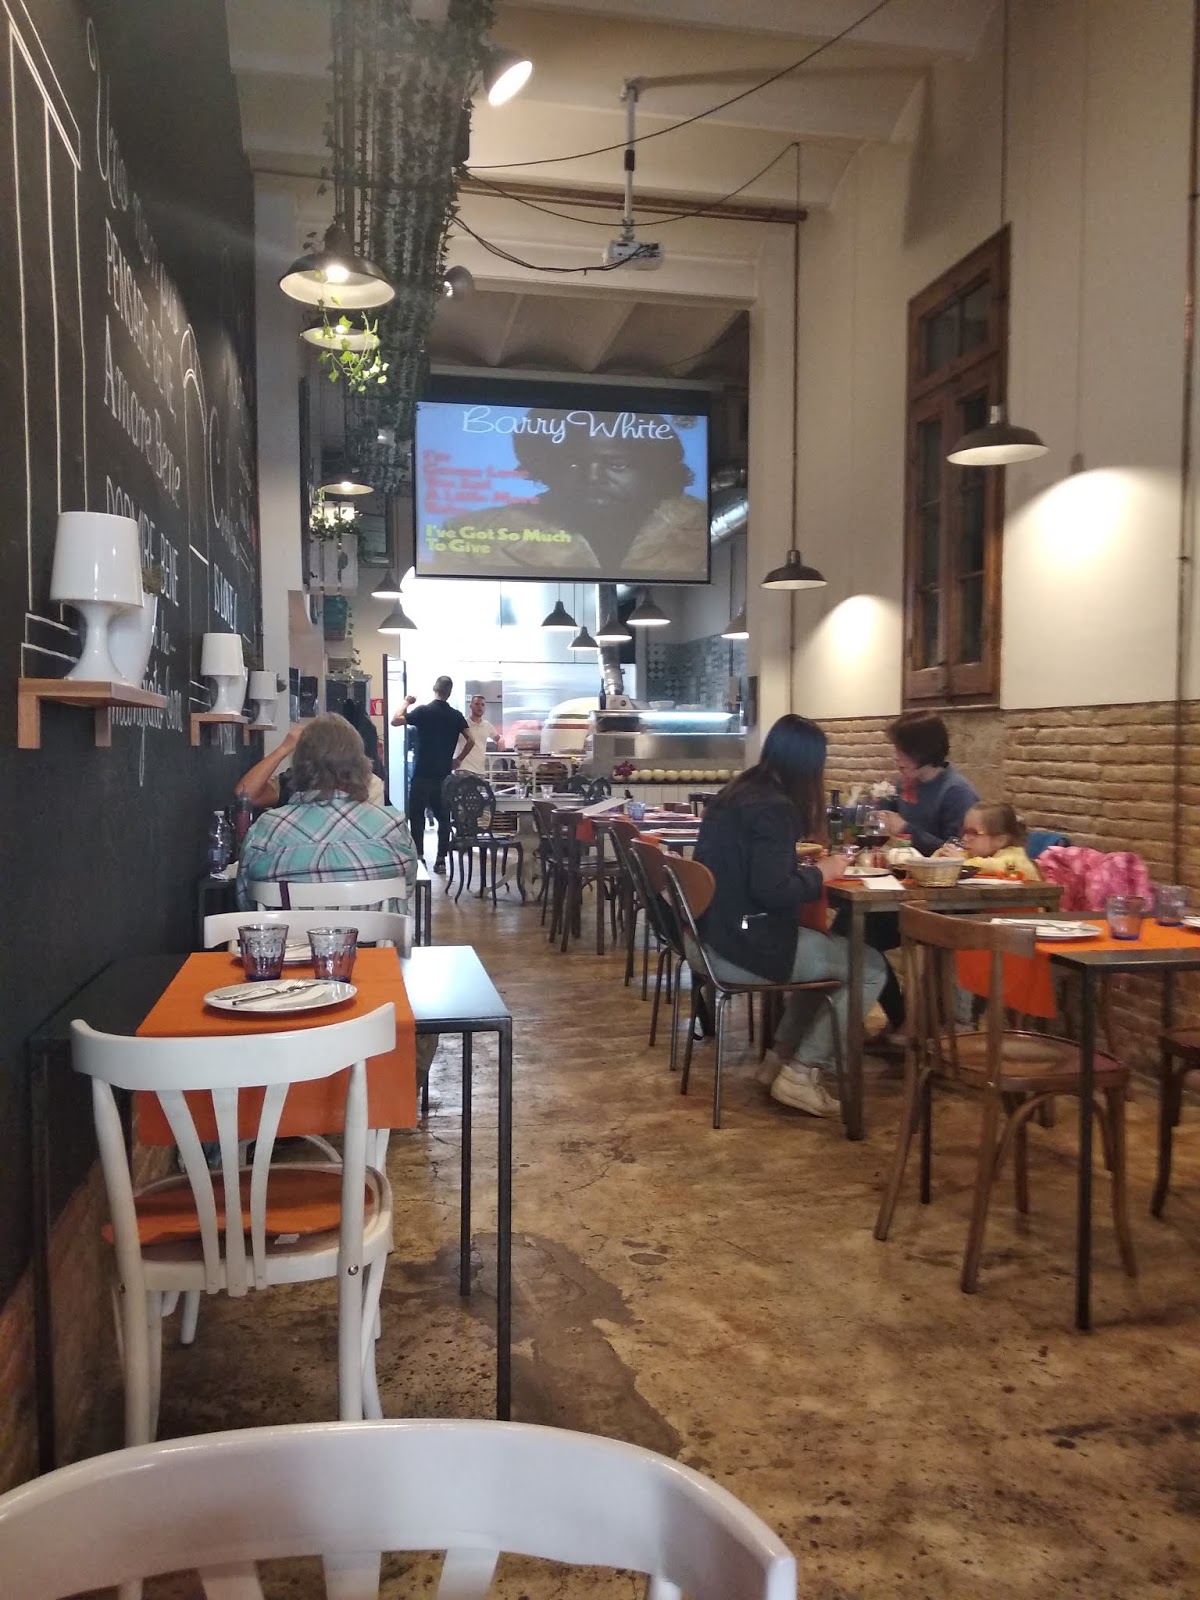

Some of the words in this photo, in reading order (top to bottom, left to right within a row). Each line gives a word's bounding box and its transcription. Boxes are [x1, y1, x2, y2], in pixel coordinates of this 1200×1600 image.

[462, 405, 566, 443] Barry
[566, 410, 674, 440] White
[426, 524, 457, 539] I've
[459, 526, 495, 540] Got
[497, 528, 520, 541] So
[523, 529, 572, 543] Much
[426, 537, 447, 551] To
[449, 539, 491, 554] Give
